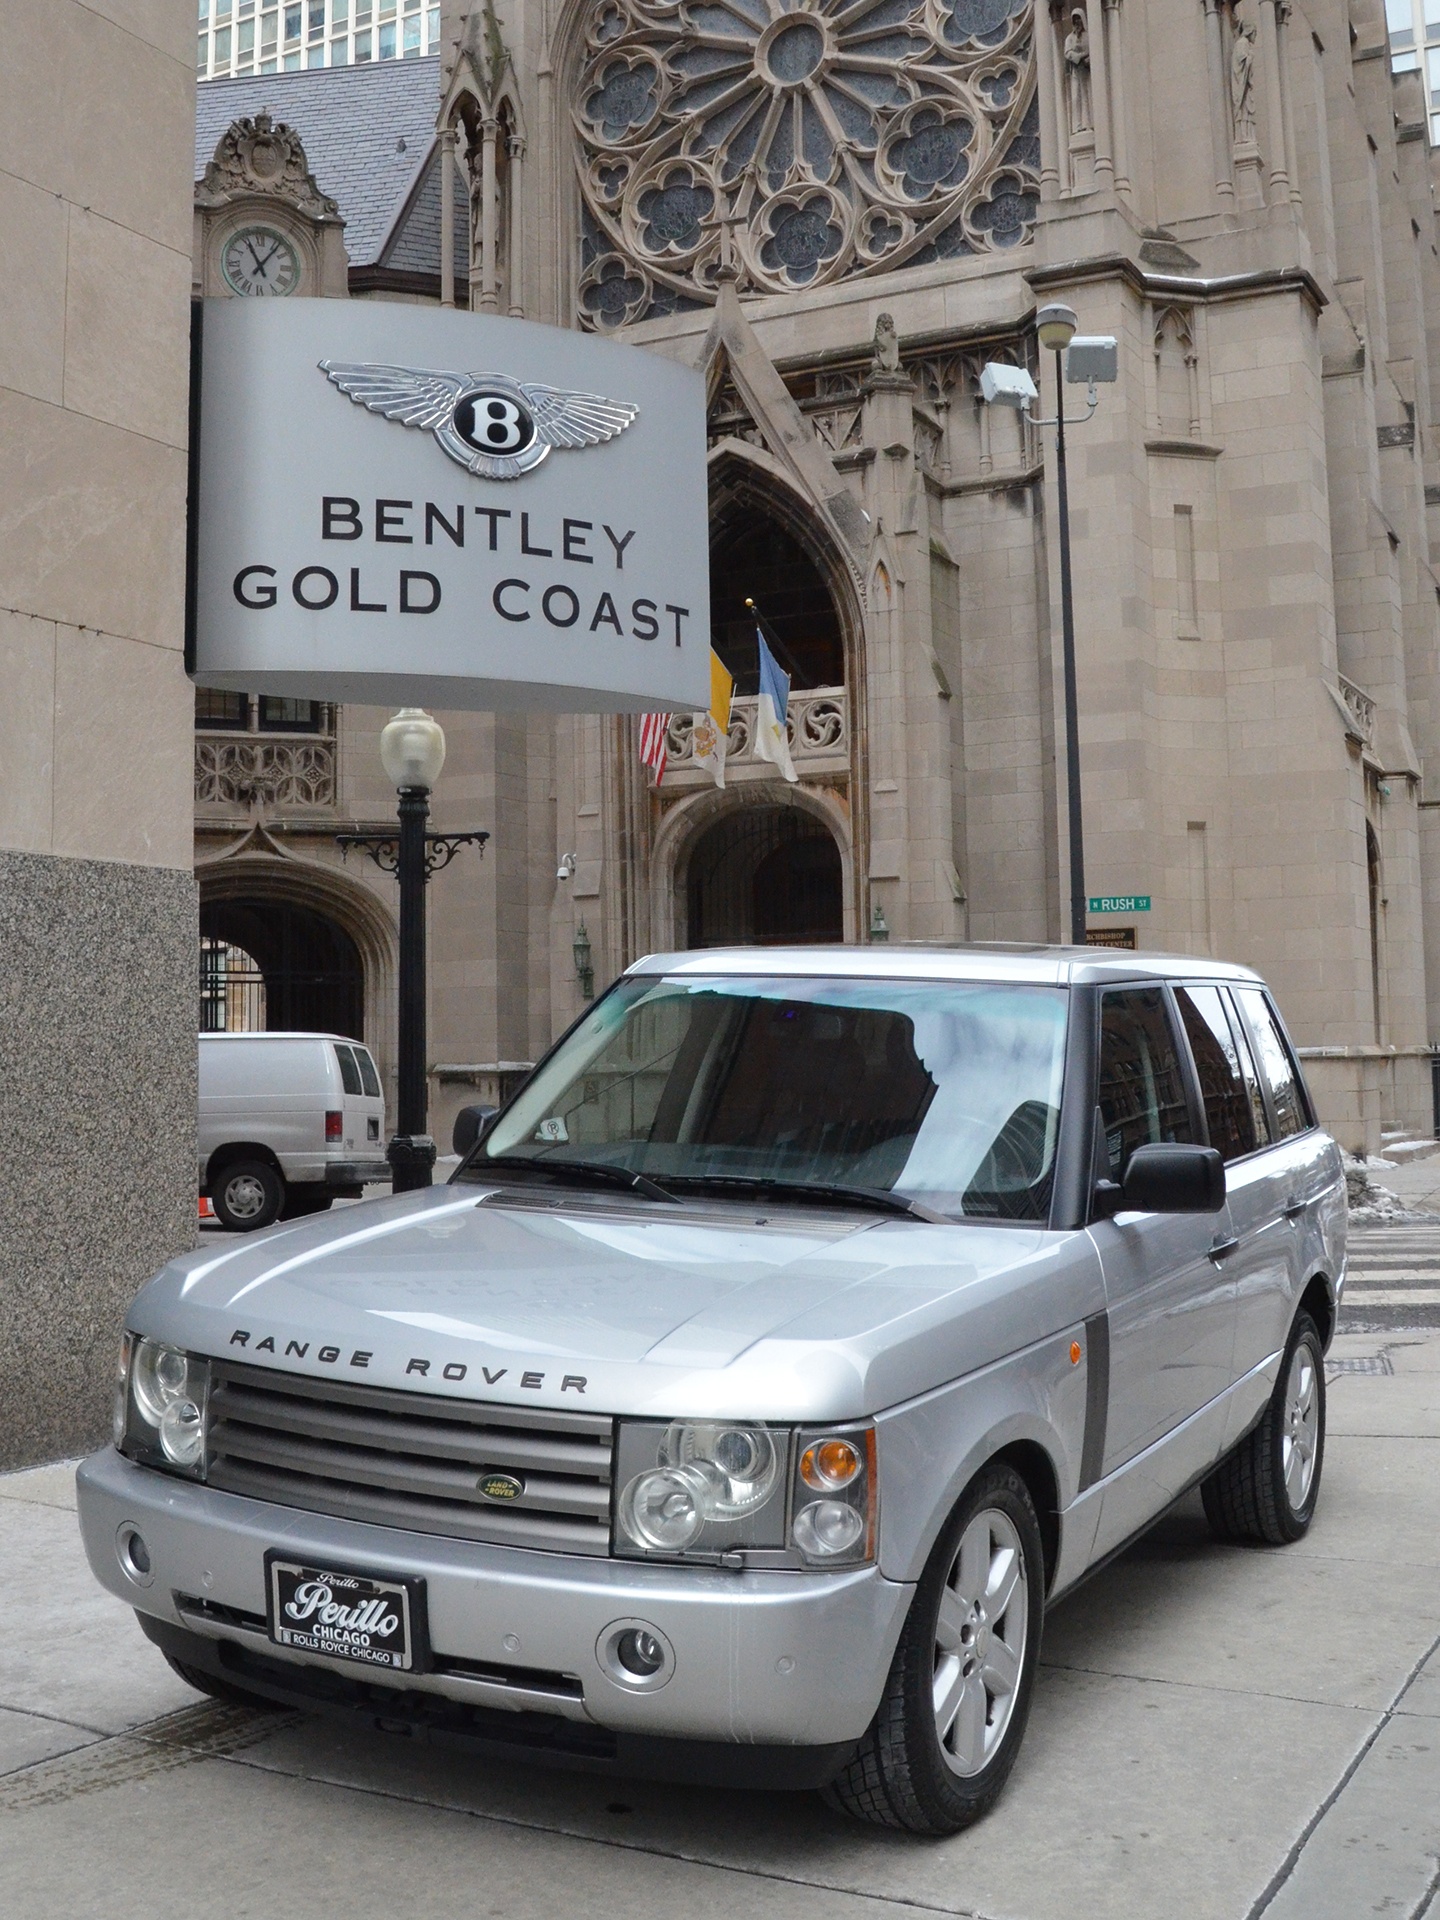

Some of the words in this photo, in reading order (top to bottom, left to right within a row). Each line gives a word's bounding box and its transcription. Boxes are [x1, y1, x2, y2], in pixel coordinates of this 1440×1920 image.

[470, 397, 520, 449] B
[321, 496, 636, 569] BENTLEY
[232, 564, 442, 615] GOLD
[492, 578, 690, 647] COAST
[1093, 901, 1098, 909] N
[1101, 898, 1135, 910] RUSH
[1138, 899, 1147, 907] ST
[229, 1329, 373, 1368] RANGE
[405, 1358, 588, 1394] ROVER
[489, 1487, 515, 1496] ROVER
[316, 1572, 359, 1589] Perillo
[285, 1582, 398, 1637] Perillo
[293, 1634, 319, 1648] ROLLS
[320, 1640, 349, 1655] ROYCE
[351, 1646, 390, 1663] CHICAGO
[312, 1624, 370, 1646] CHICAGO
